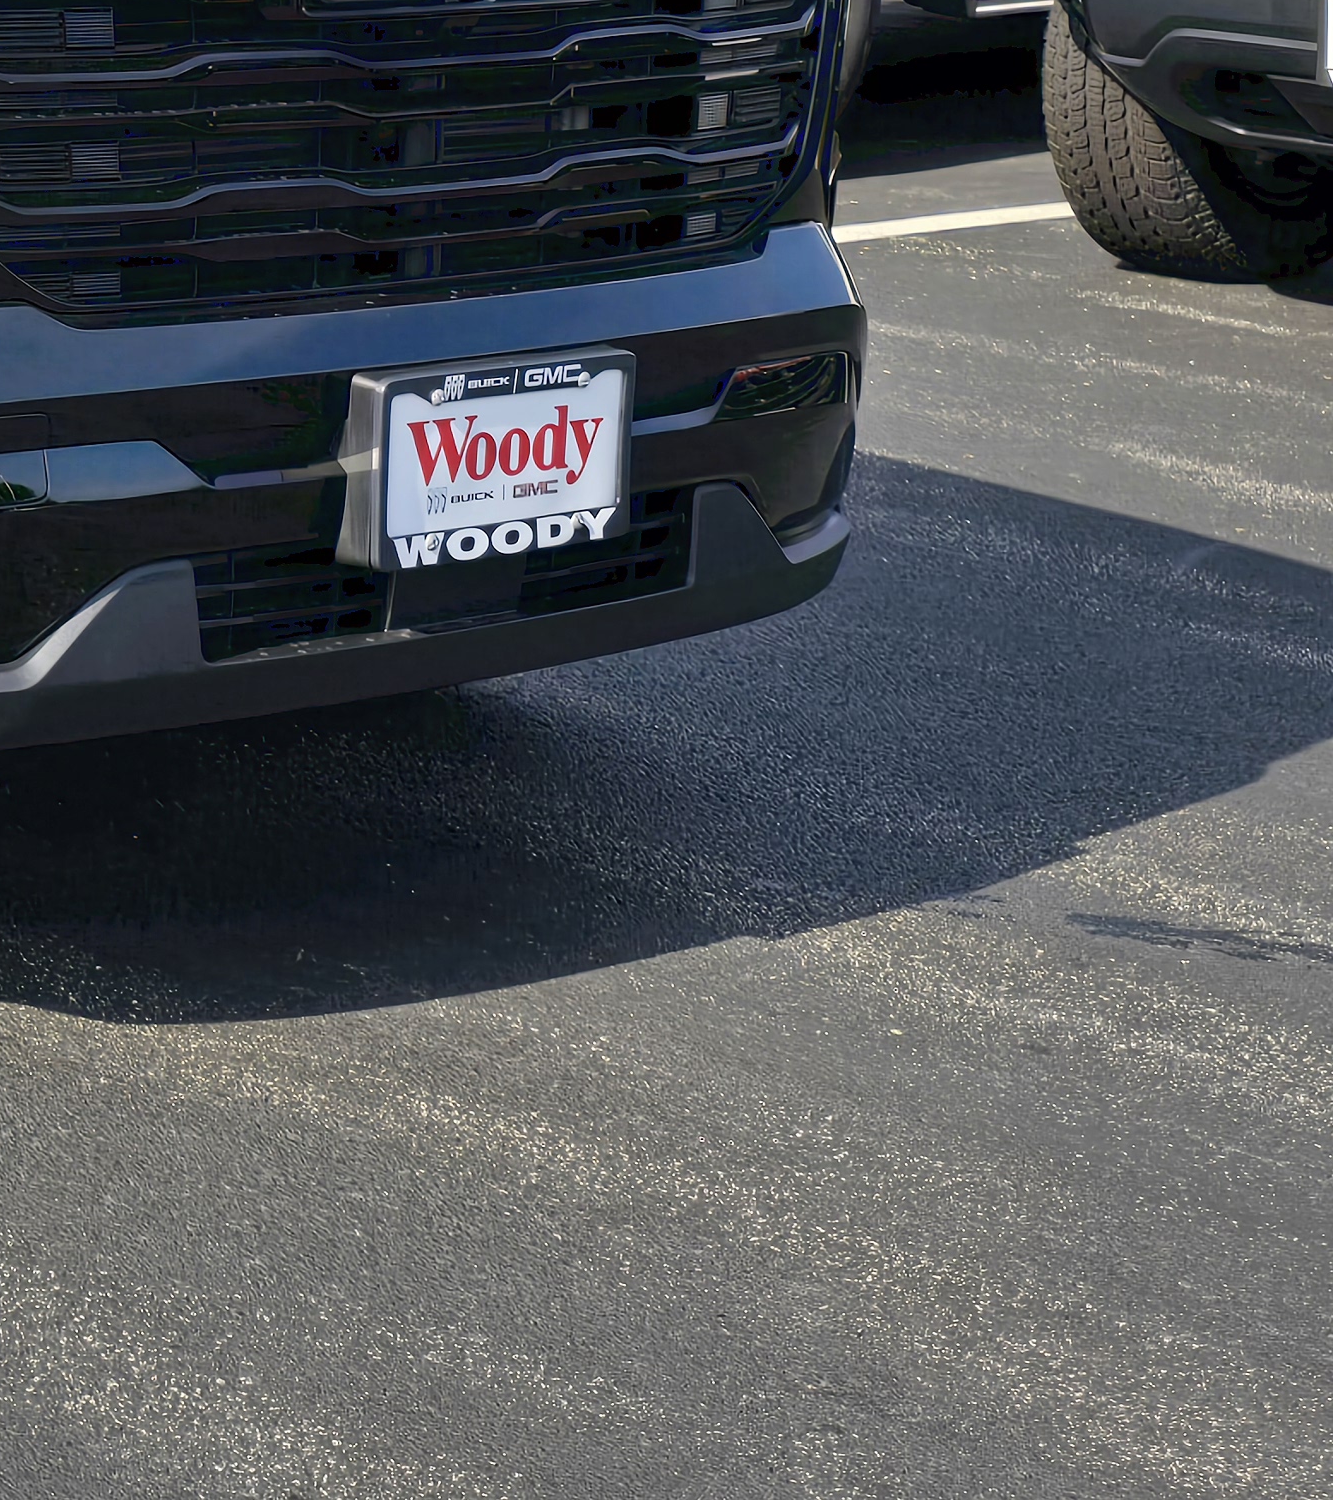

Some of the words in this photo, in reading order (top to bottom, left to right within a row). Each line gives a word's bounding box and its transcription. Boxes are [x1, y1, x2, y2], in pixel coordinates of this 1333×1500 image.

[468, 376, 510, 389] BUICK
[524, 363, 583, 388] GMC
[407, 405, 604, 486] Woody
[450, 490, 494, 504] BUICK
[513, 479, 559, 498] GMC
[394, 507, 616, 569] WOODY
